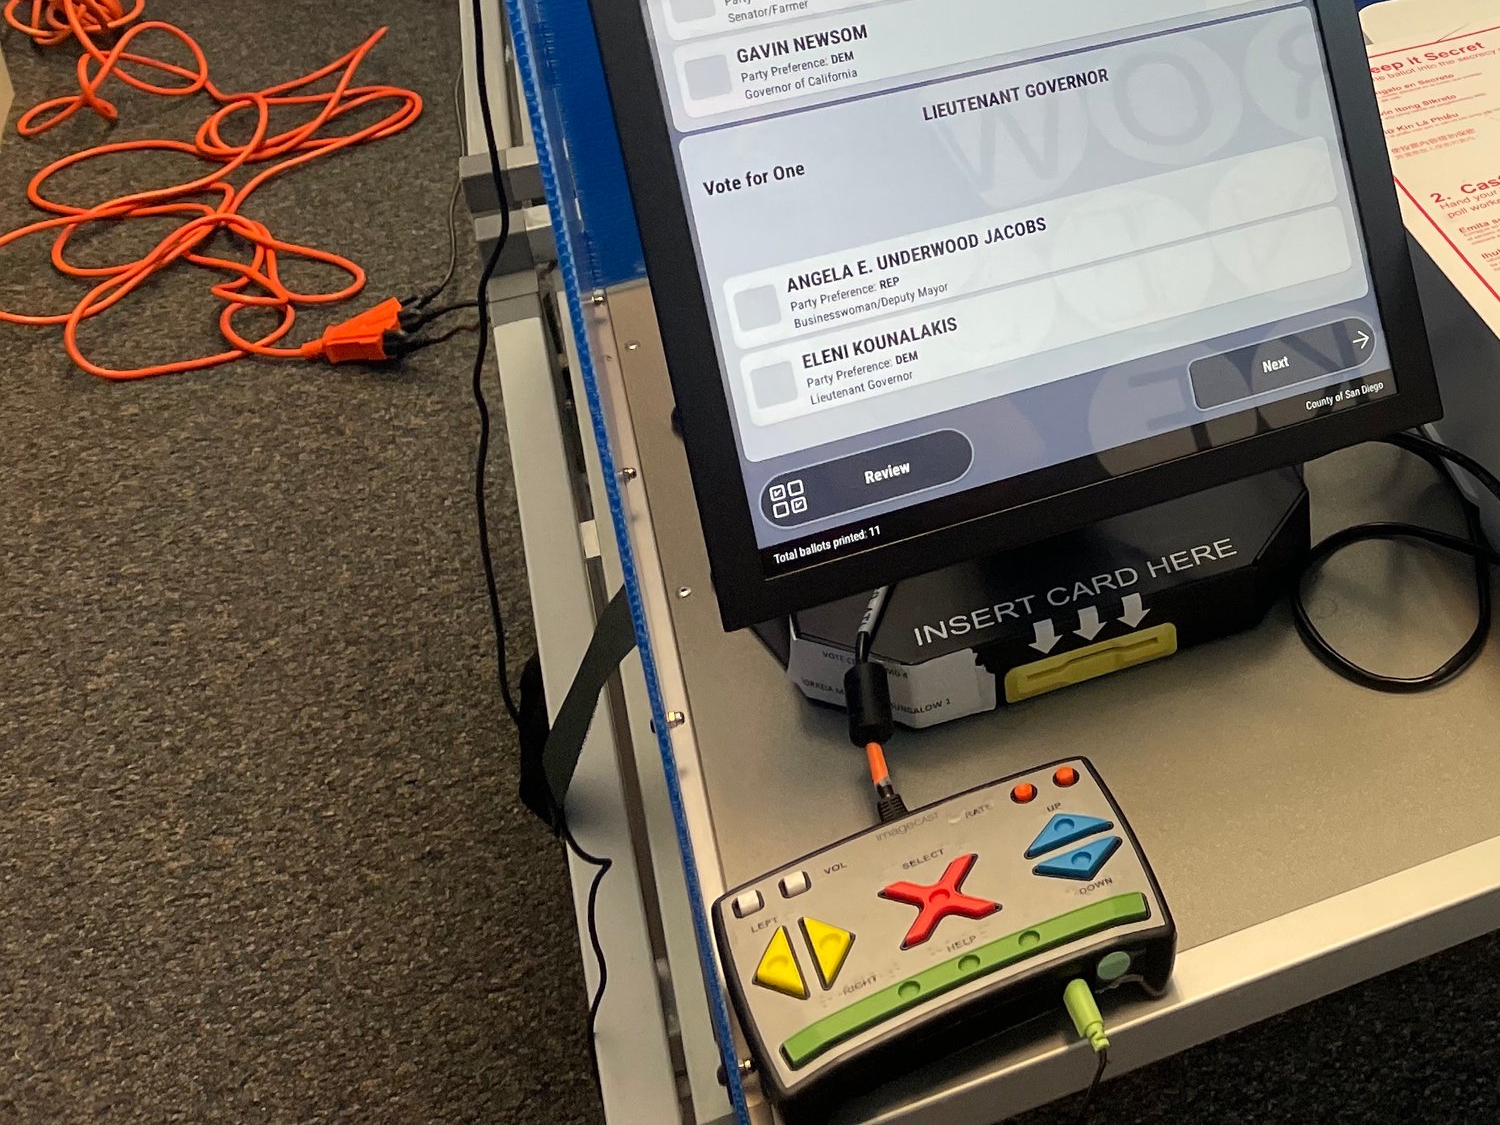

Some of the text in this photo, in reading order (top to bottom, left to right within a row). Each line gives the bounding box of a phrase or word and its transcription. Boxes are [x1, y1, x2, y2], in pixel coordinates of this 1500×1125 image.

[727, 0, 808, 22] Senator/Farmer
[736, 24, 867, 62] GAVIN NEWSOM
[1407, 41, 1485, 64] it Secret
[740, 50, 854, 82] Party Preference: DEM
[744, 69, 857, 99] Governor of California
[922, 68, 1108, 120] LIEUTENANT GOVERNOR
[1429, 192, 1451, 204] 2.
[787, 217, 1046, 292] ANGELA E. UNDERWOOD JACOBS
[793, 283, 947, 328] Businesswoman/Deputy Mayor
[801, 316, 957, 368] ELENI KOUNALAKIS
[1262, 356, 1289, 372] Next
[864, 462, 909, 484] Review
[772, 525, 880, 563] Total ballots printed: 11
[914, 594, 1034, 645] INSERT
[1046, 567, 1138, 605] CARD
[1146, 538, 1237, 577] HERE
[1046, 801, 1062, 814] UP
[823, 861, 848, 875] VOL
[901, 847, 945, 871] SELECT
[1078, 876, 1114, 896] DOWN
[750, 915, 780, 934] LEFT
[946, 935, 977, 954] HELP
[842, 973, 878, 997] RIGHT
